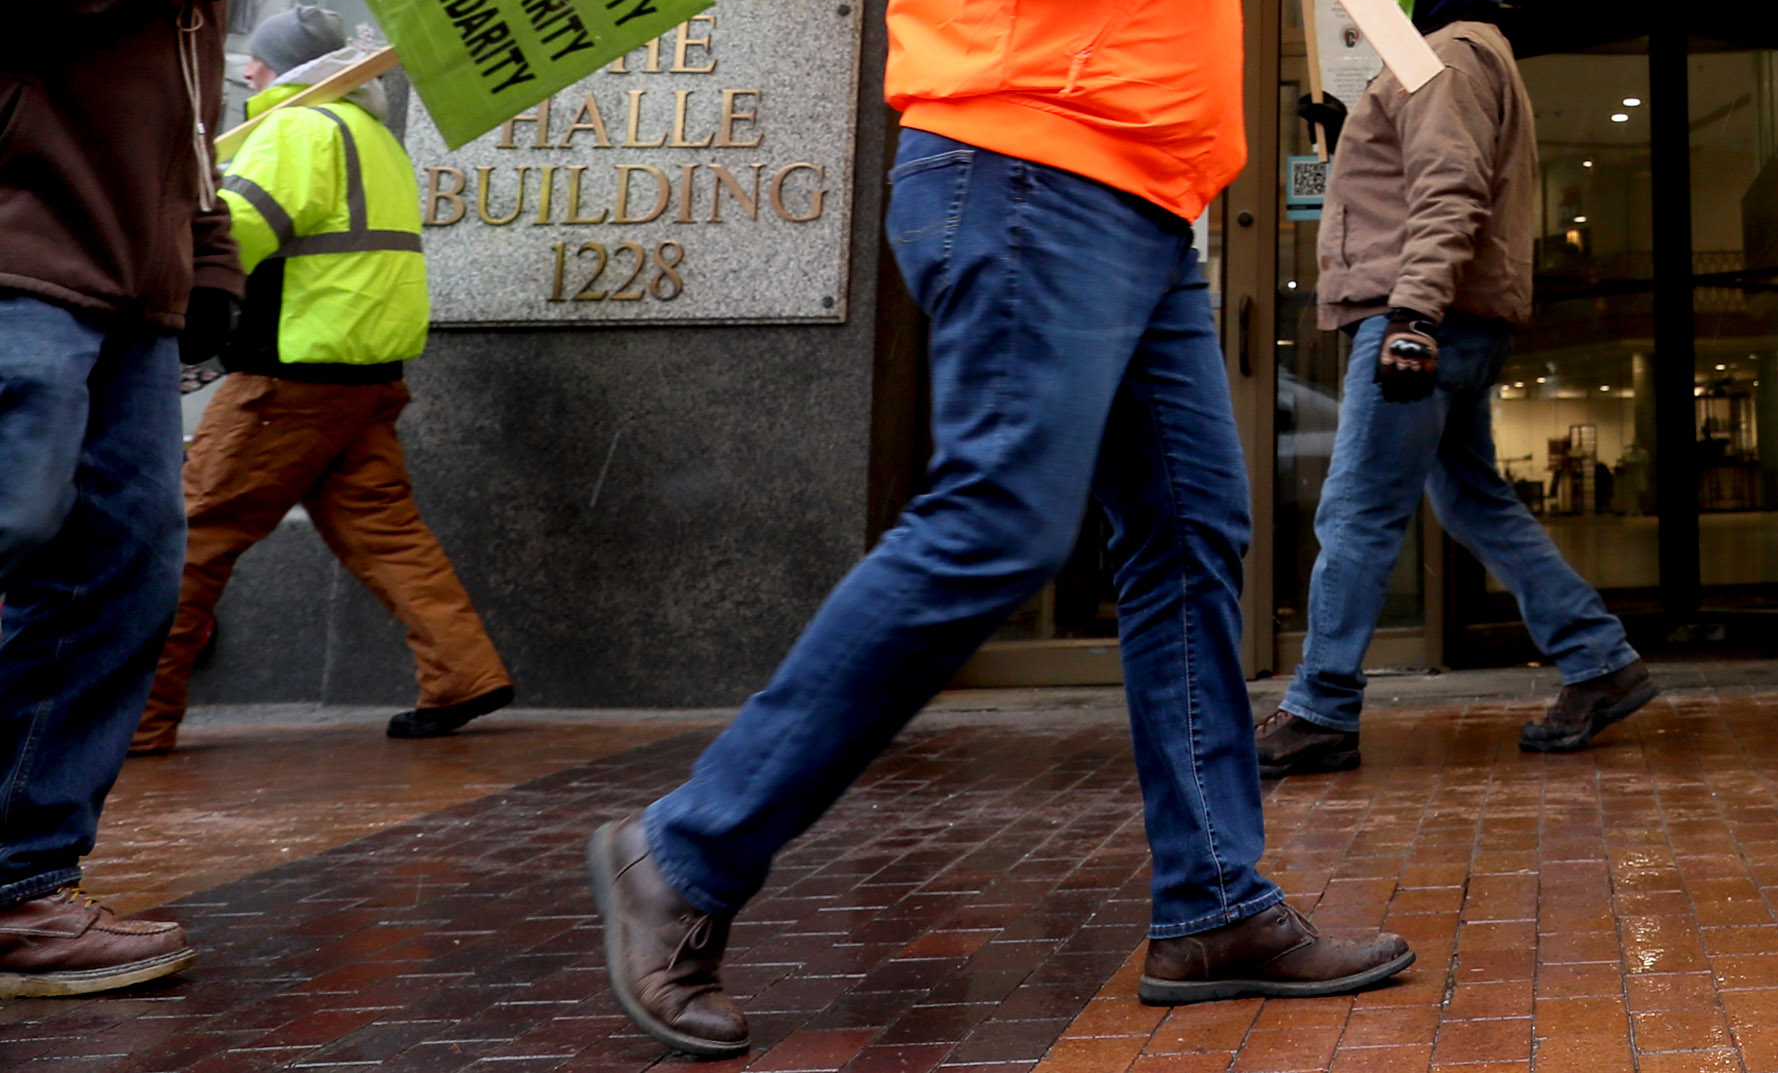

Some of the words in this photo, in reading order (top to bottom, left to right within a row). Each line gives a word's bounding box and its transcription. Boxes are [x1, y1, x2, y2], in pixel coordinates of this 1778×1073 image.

[496, 88, 765, 149] HALLE
[423, 162, 828, 228] BUILDING
[547, 240, 685, 303] 1228
